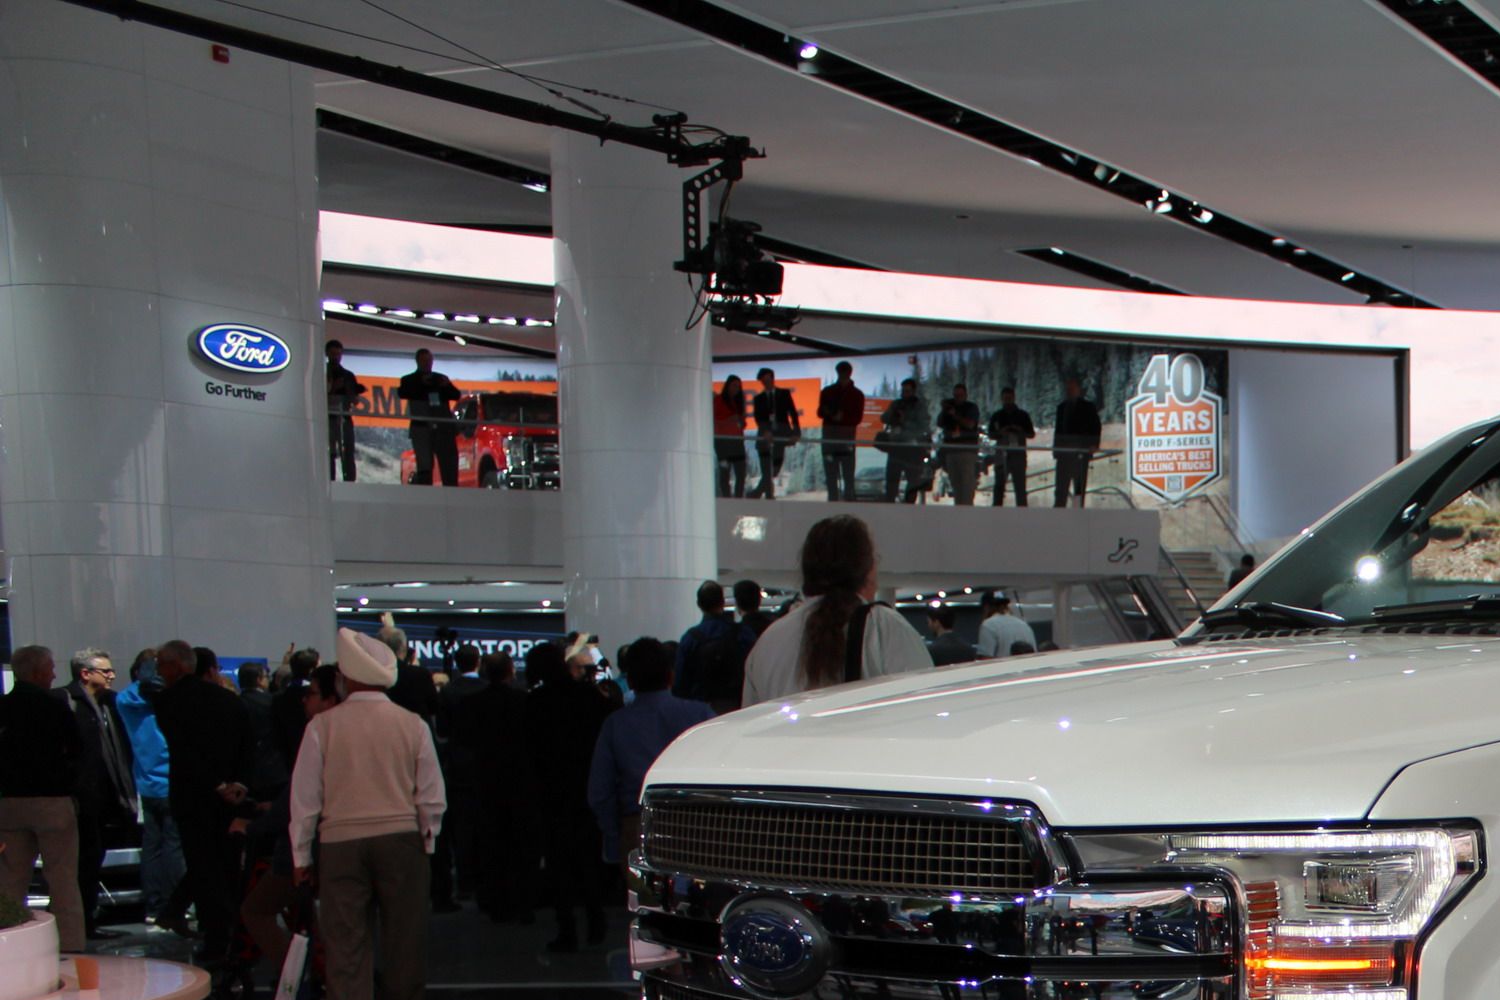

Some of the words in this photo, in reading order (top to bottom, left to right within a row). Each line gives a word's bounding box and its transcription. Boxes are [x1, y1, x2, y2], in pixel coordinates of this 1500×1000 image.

[220, 330, 275, 366] Ford
[1138, 353, 1205, 407] 40
[205, 381, 223, 396] Go
[224, 384, 267, 401] Further
[1137, 409, 1212, 433] YEARS
[1137, 439, 1163, 448] FORD
[1167, 435, 1211, 447] F-SERIES
[1138, 453, 1186, 462] AMERICA'S
[1188, 451, 1211, 460] BEST
[1138, 462, 1175, 472] SELLING
[1177, 460, 1212, 470] TRUCKS
